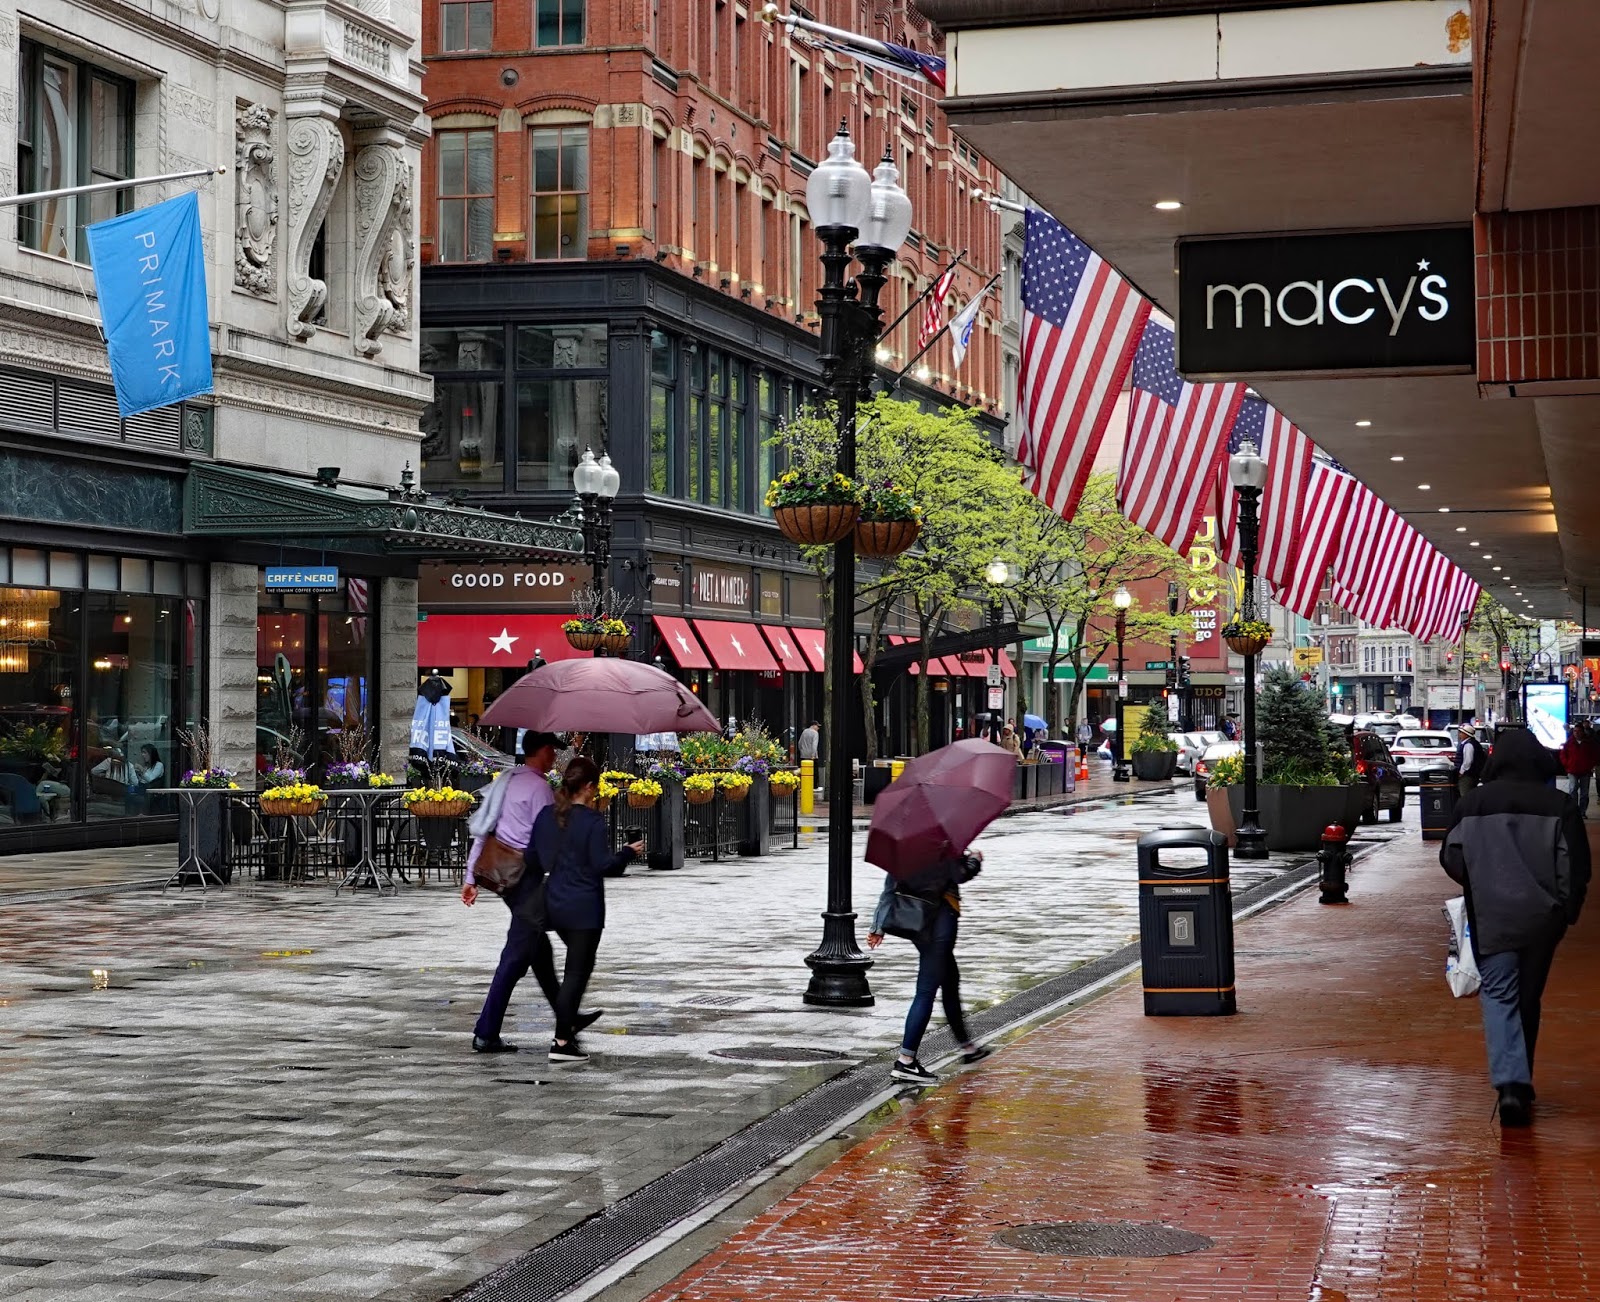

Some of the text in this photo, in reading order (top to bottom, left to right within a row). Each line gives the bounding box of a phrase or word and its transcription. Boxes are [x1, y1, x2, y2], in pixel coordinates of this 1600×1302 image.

[135, 231, 181, 384] PRIMARK
[267, 572, 335, 583] CAFFÈ NERO
[451, 572, 565, 588] GOOD FOOD
[699, 571, 745, 605] PRET A MANGER
[1195, 630, 1212, 642] go
[763, 670, 776, 679] PRET
[1194, 687, 1223, 697] UDG
